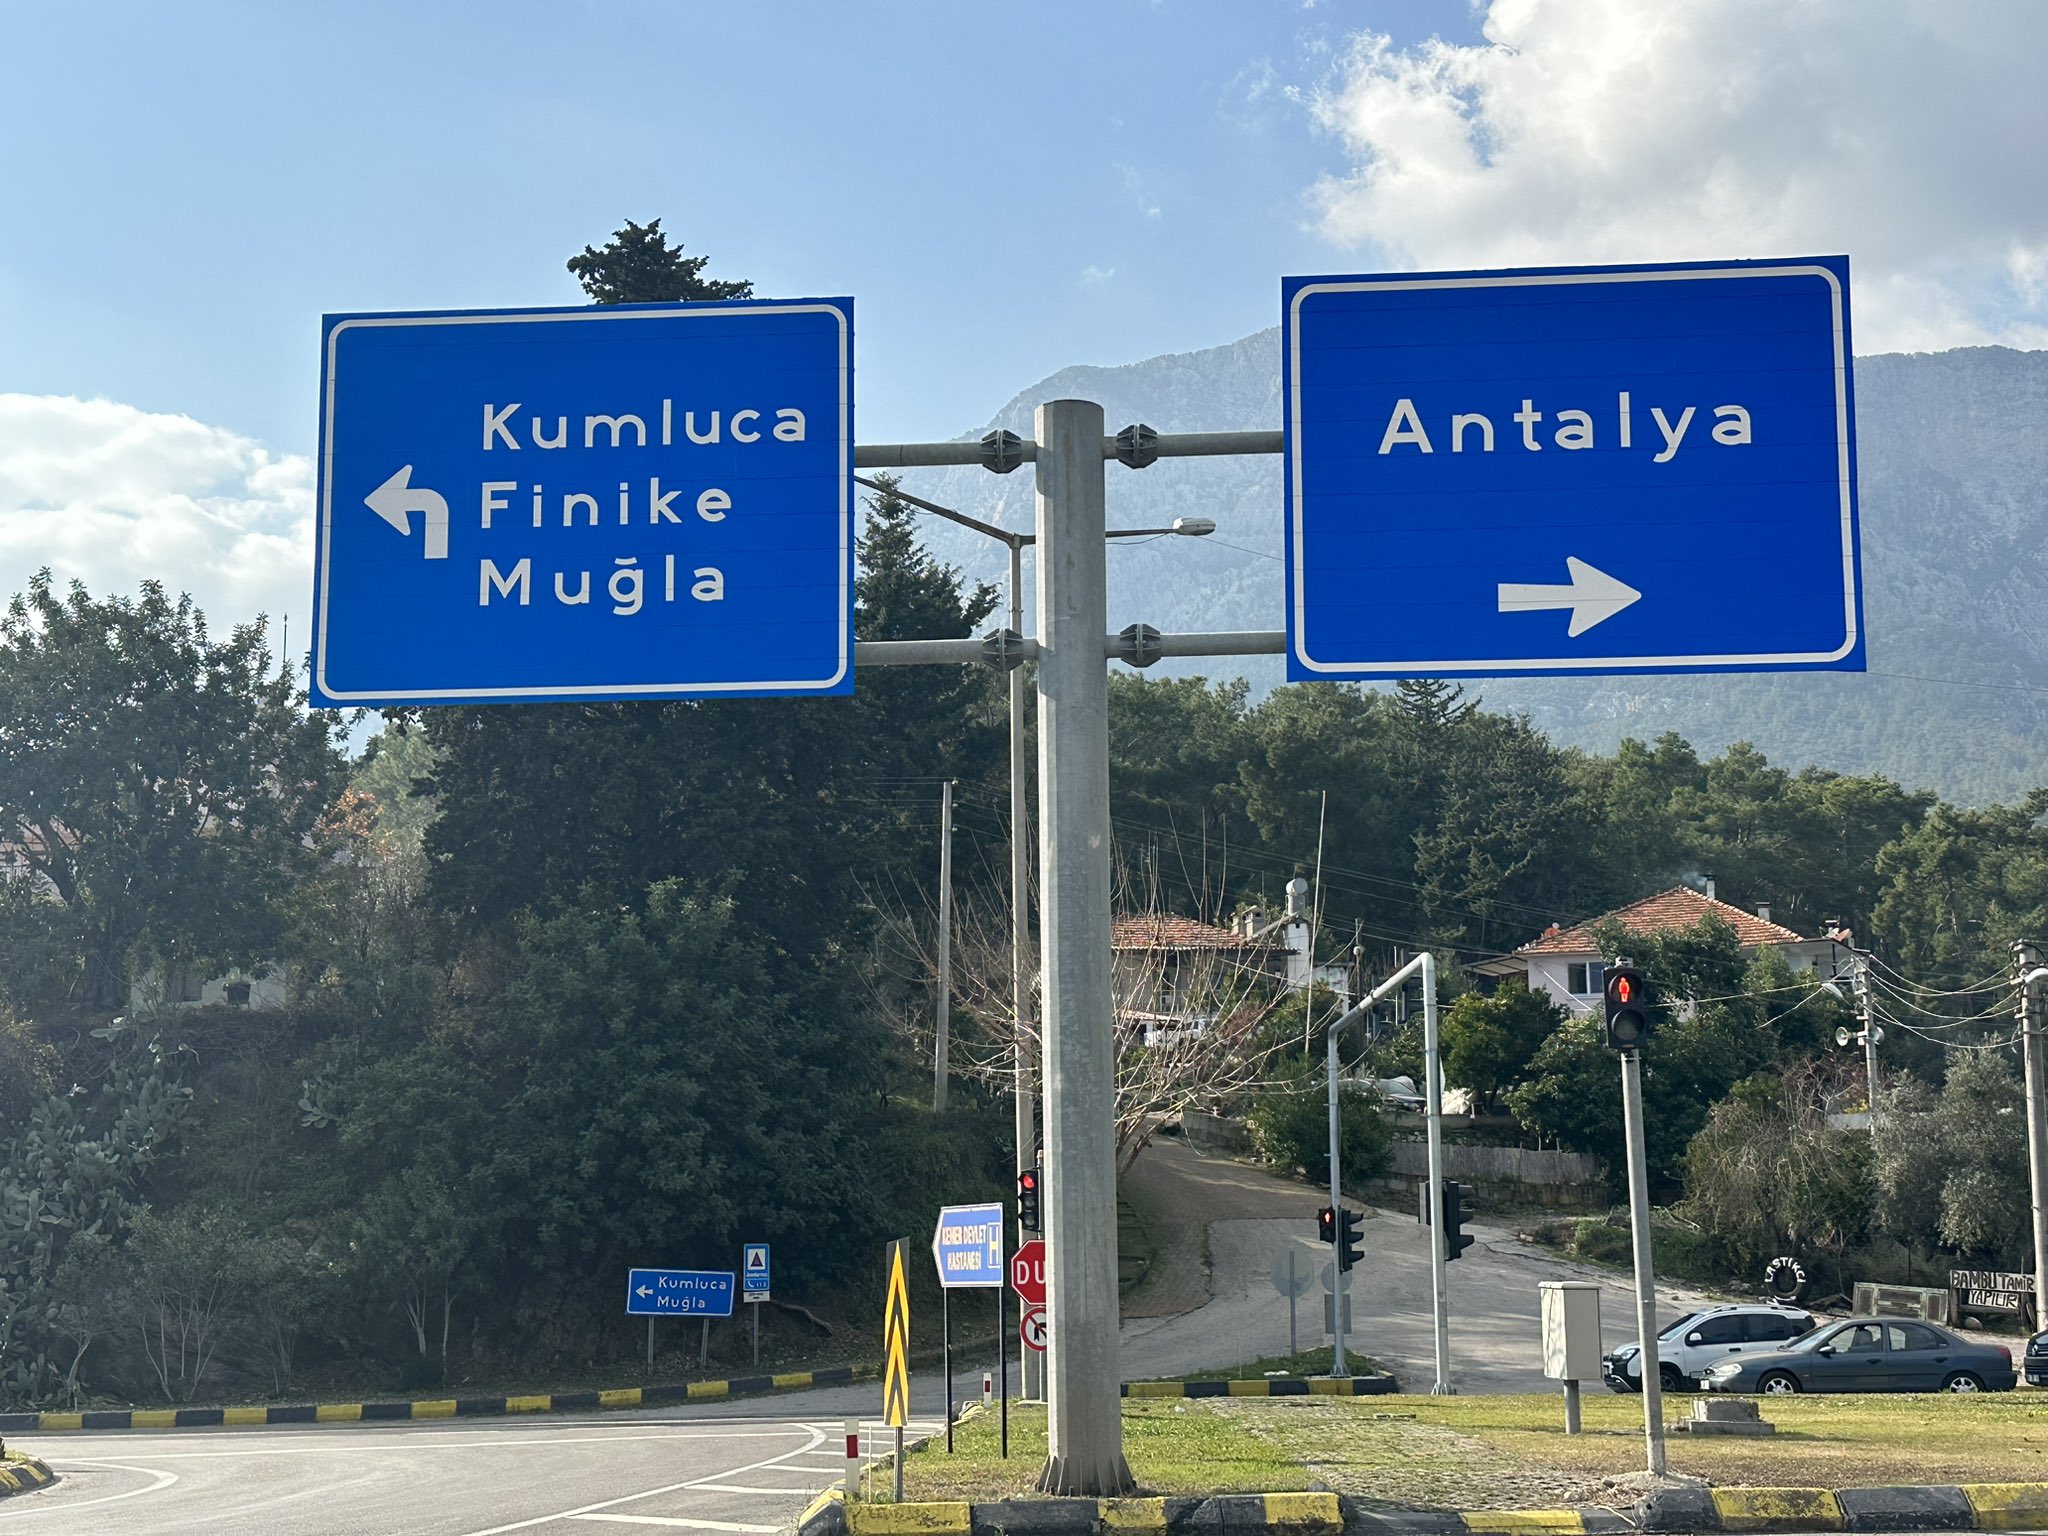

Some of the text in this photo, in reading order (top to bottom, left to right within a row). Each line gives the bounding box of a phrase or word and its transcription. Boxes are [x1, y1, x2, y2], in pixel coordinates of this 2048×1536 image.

[482, 398, 806, 451] Kumluca
[1378, 391, 1752, 463] Antalya
[481, 477, 732, 529] Finike
[479, 553, 725, 616] Muğla
[942, 1224, 987, 1245] KEMER DEVLET
[658, 1276, 727, 1290] Kumluca
[1016, 1260, 1046, 1284] DU
[657, 1295, 706, 1312] Muğla
